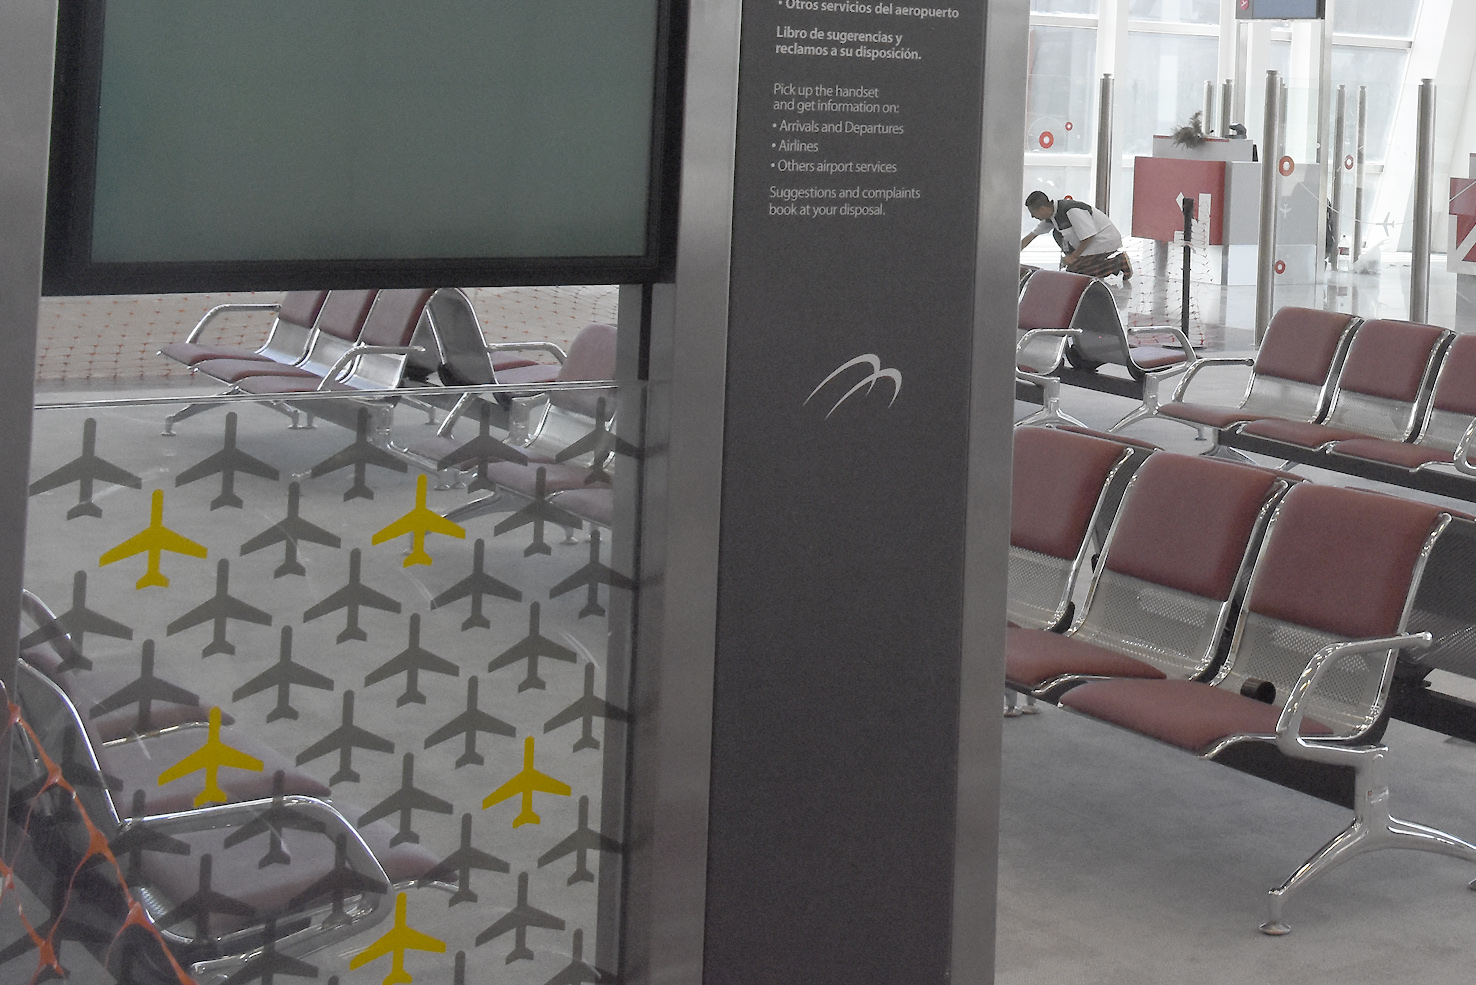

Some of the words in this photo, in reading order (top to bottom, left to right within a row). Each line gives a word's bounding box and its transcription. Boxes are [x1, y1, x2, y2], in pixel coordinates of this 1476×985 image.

[821, 0, 872, 13] servicios
[875, 2, 893, 15] del
[895, 5, 960, 19] aeropuerto
[776, 26, 807, 39] Libro
[809, 27, 824, 40] de
[827, 29, 893, 44] sugerencias
[895, 34, 903, 46] y
[775, 43, 828, 56] reclamos
[830, 47, 837, 56] a
[839, 47, 853, 57] su
[855, 46, 922, 60] disposición.
[773, 83, 796, 95] Pick
[798, 86, 813, 98] up
[815, 84, 833, 97] the
[835, 85, 879, 98] handset
[773, 99, 795, 110] and
[797, 100, 815, 113] get
[817, 99, 880, 113] information
[882, 104, 900, 113] on:
[779, 119, 820, 133] Arrivals
[821, 121, 843, 133] and
[845, 121, 904, 136] Departures
[778, 139, 819, 152] Airlines
[777, 159, 815, 172] Others
[816, 159, 853, 175] airport
[855, 161, 897, 173] services
[769, 185, 837, 201] Suggestions
[839, 186, 860, 198] and
[862, 187, 921, 201] complaints
[769, 203, 797, 215] book
[799, 204, 811, 215] at
[812, 205, 837, 218] your
[839, 203, 885, 218] disposal.
